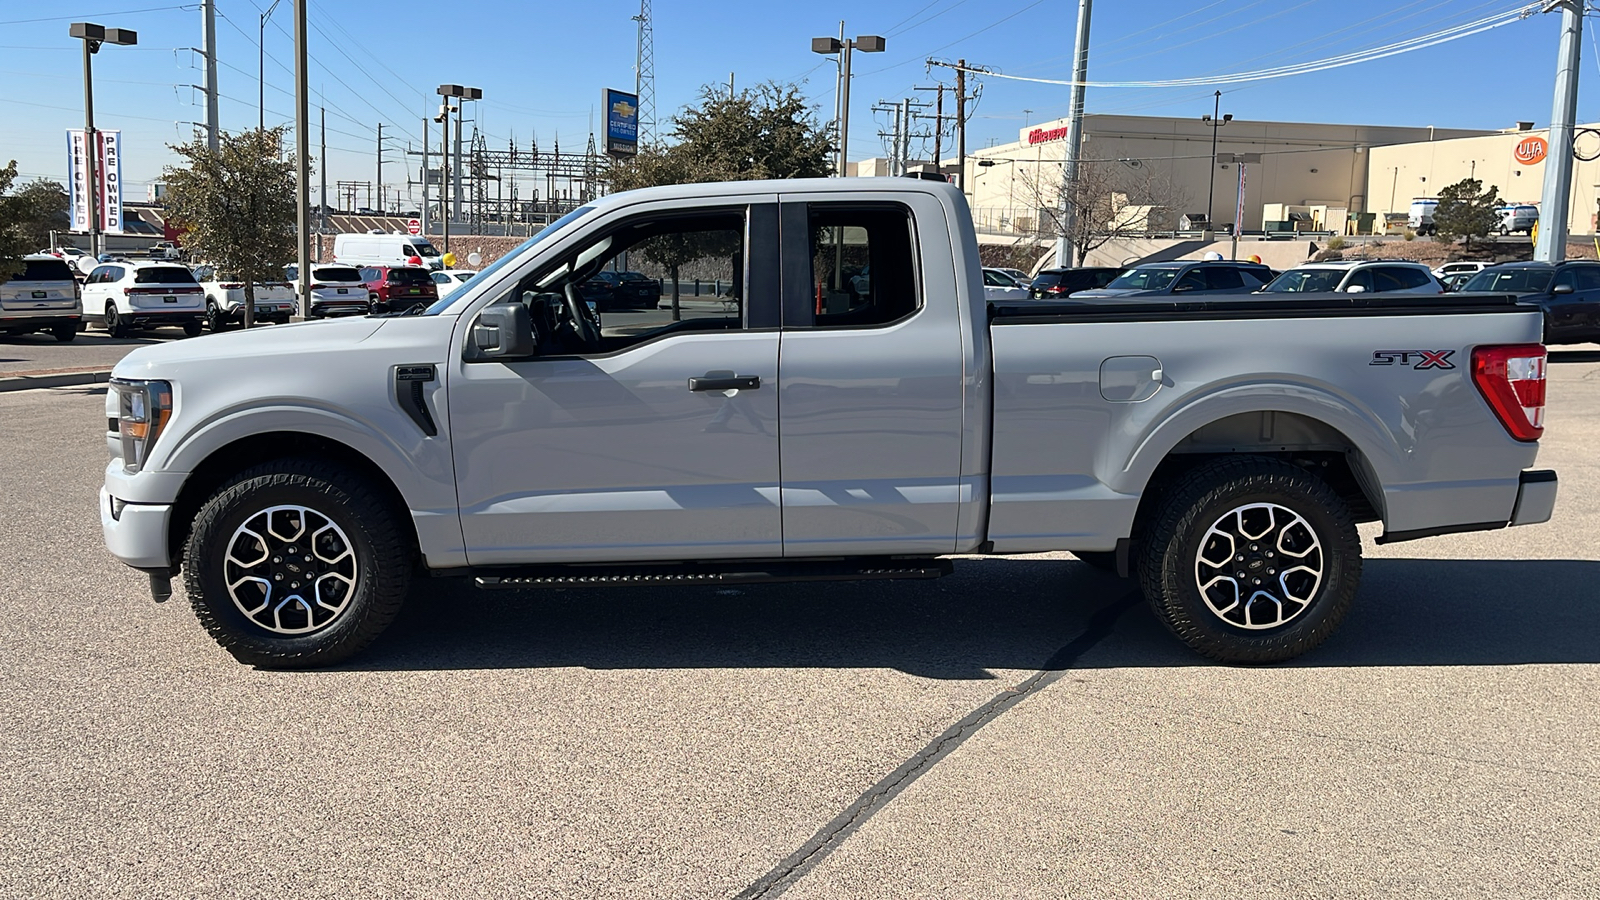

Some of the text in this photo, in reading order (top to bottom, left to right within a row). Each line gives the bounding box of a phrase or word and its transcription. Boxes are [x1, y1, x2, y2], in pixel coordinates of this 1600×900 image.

[609, 120, 636, 131] CERTIFIED
[611, 127, 635, 136] PRE-OWNED
[1028, 128, 1048, 145] Office
[1518, 141, 1543, 156] ULTA
[73, 136, 86, 225] PRE OWNED
[106, 136, 118, 227] PRE OWNED
[1369, 349, 1456, 370] STX
